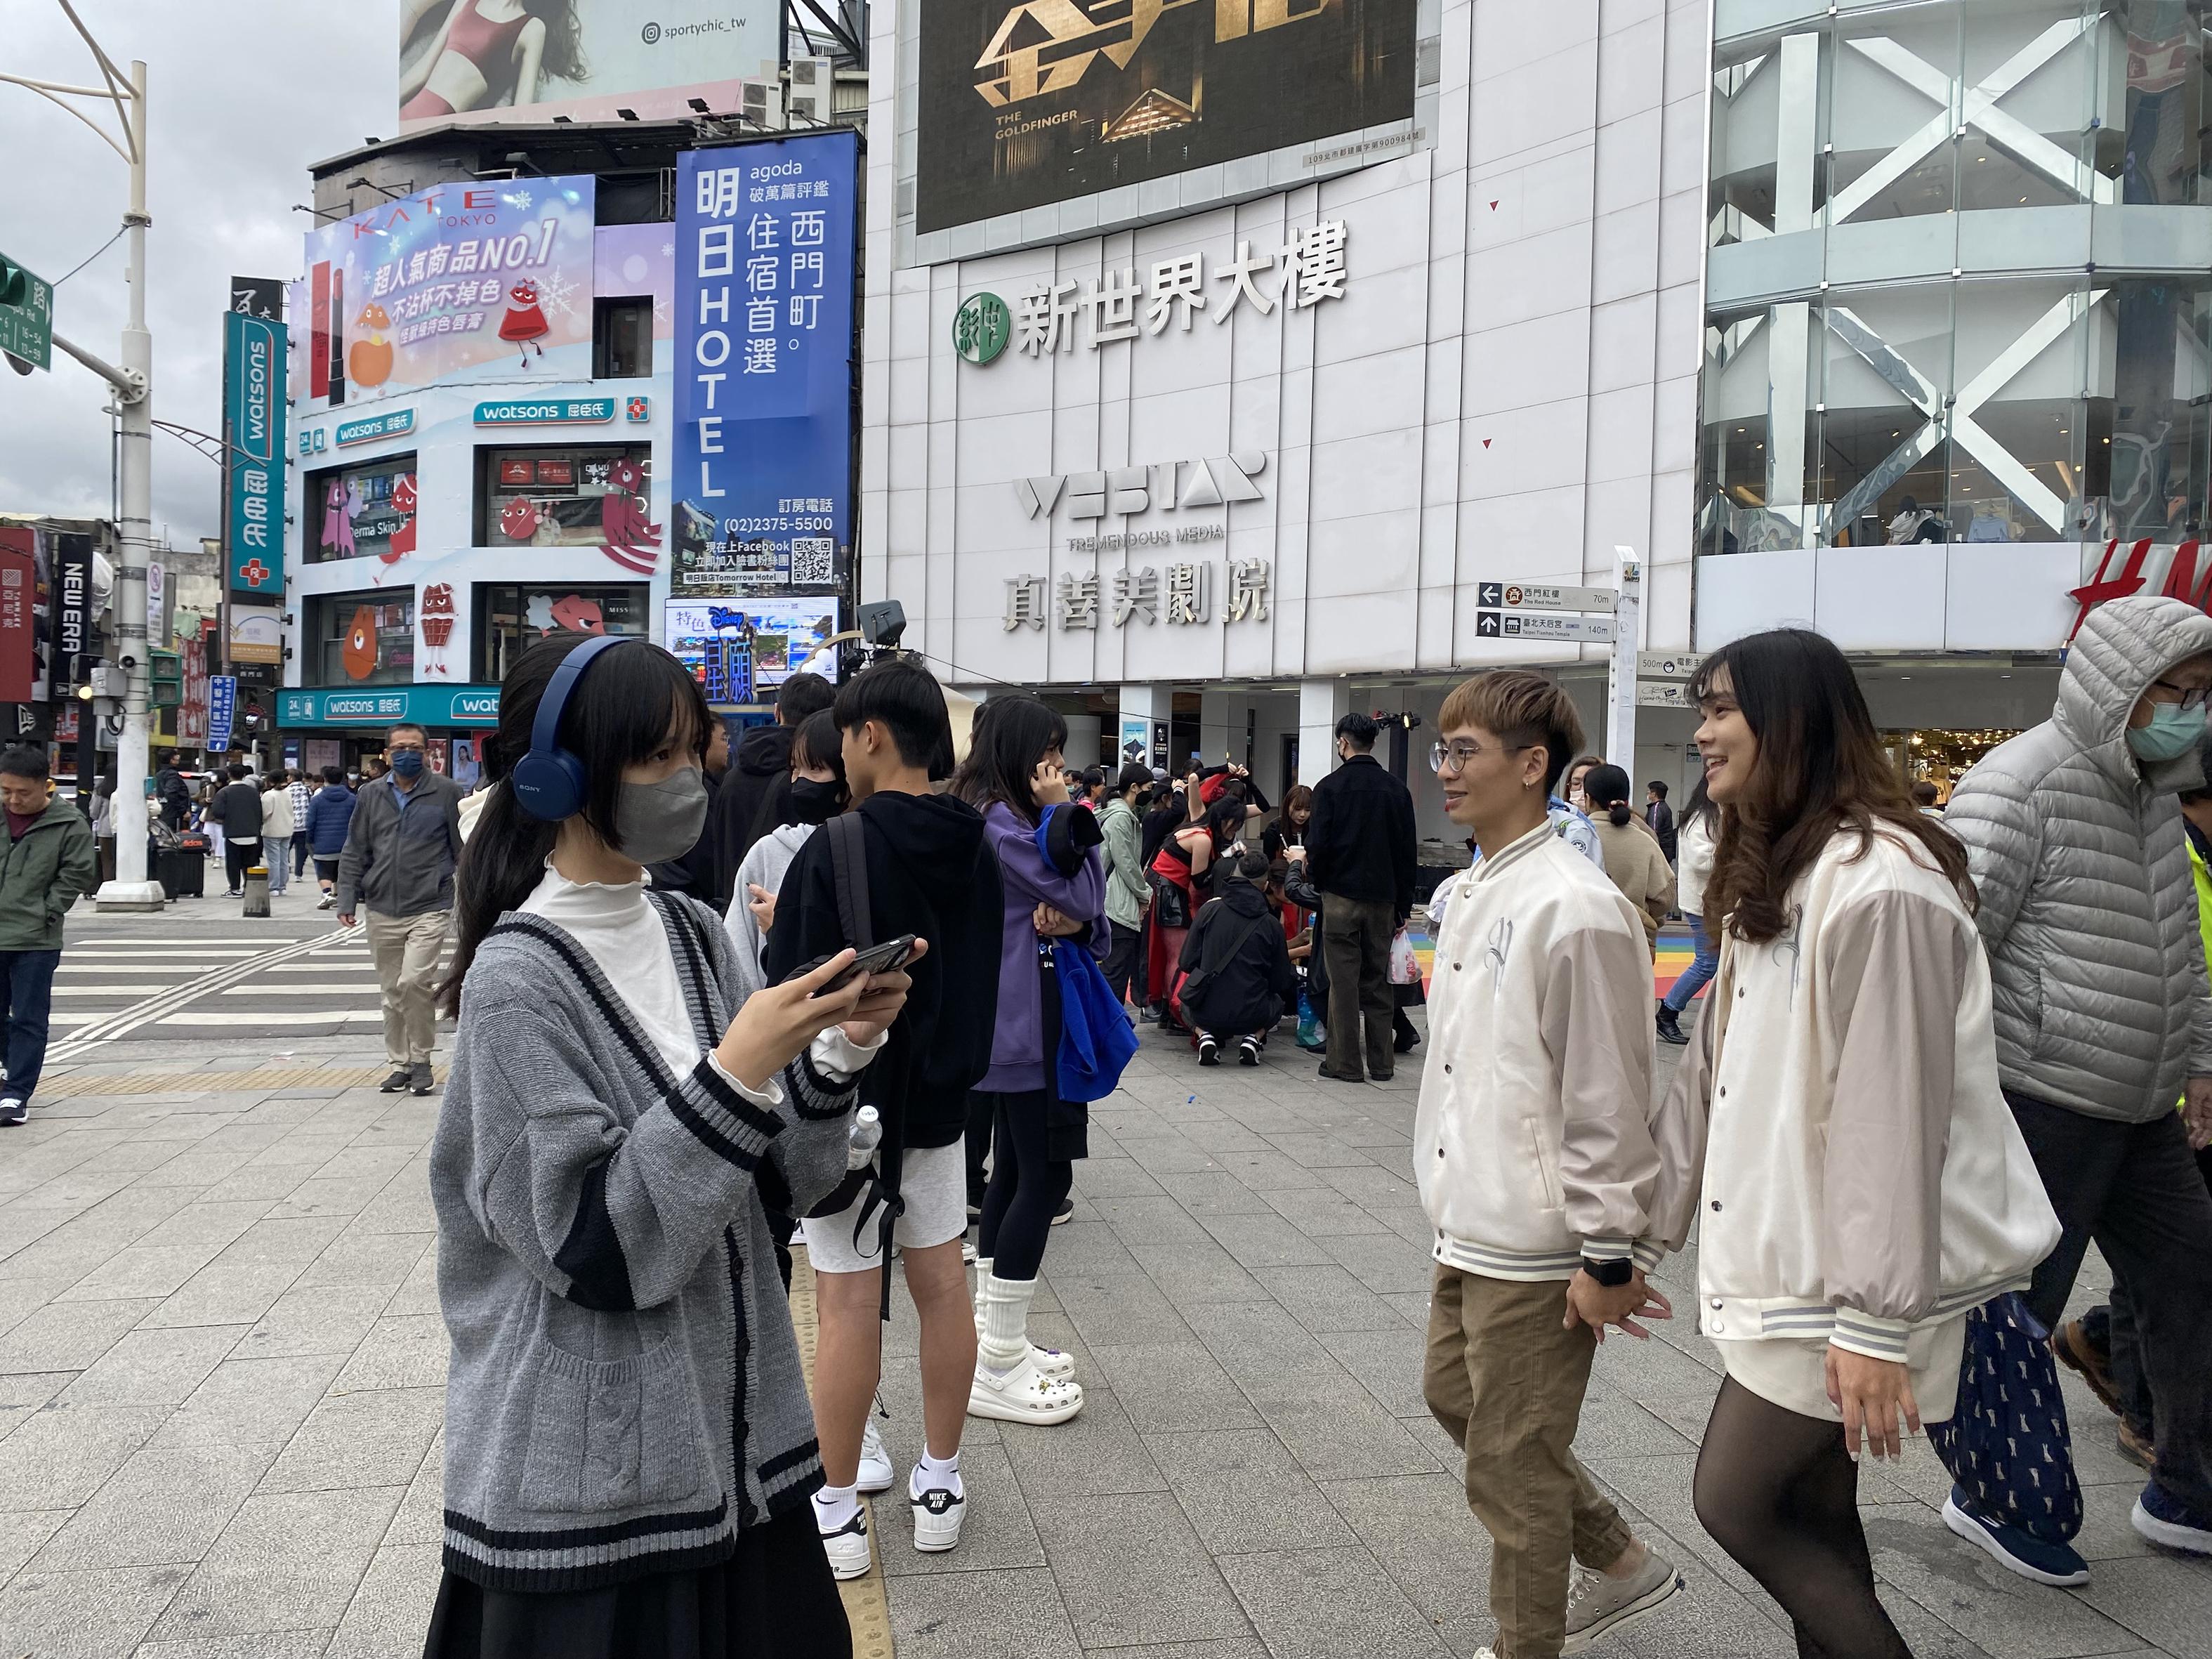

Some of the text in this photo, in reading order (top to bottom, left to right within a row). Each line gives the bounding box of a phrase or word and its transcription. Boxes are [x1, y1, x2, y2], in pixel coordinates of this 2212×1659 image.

[665, 18, 746, 39] sportychic_tw
[995, 110, 1078, 140] GOLDFINGER
[996, 111, 1022, 126] THE
[750, 159, 803, 183] agoda
[749, 180, 829, 203] 破萬篇評鑑
[354, 190, 496, 240] KATE
[437, 214, 496, 228] TOKYO
[371, 218, 558, 298] 超人氣商品NO.1
[743, 212, 780, 374] 住宿首選
[1017, 218, 1350, 358] 新世界大樓
[392, 279, 501, 323] 不沾杯不掉色
[247, 341, 265, 440] watsons
[483, 402, 604, 419] watsons 屈臣氏
[341, 414, 407, 440] watsons 屈臣氏
[244, 470, 268, 548] 屈臣氏
[778, 498, 834, 513] 訂房電話
[377, 520, 396, 535] Skin
[724, 517, 833, 533] (02)2375-5500
[1067, 524, 1224, 551] TREMENDOUS MEDIA
[705, 540, 790, 553] 現在上Facebook
[694, 553, 789, 567] 立即加入臉書粉絲團
[756, 572, 777, 582] Hotel
[1002, 558, 1269, 631] 真善美劇院
[1524, 589, 1560, 598] 西門紅樓
[1593, 594, 1609, 604] 70m
[62, 563, 83, 652] NEW ERA
[1523, 618, 1562, 629] 臺北天后宮
[1588, 625, 1608, 634] 140m
[1642, 659, 1663, 668] 500m
[1677, 657, 1705, 667] 電影主
[330, 698, 401, 713] watsons 屈臣氏
[520, 784, 540, 792] SONY
[929, 1493, 947, 1501] NIKE
[930, 1500, 944, 1509] AIR
